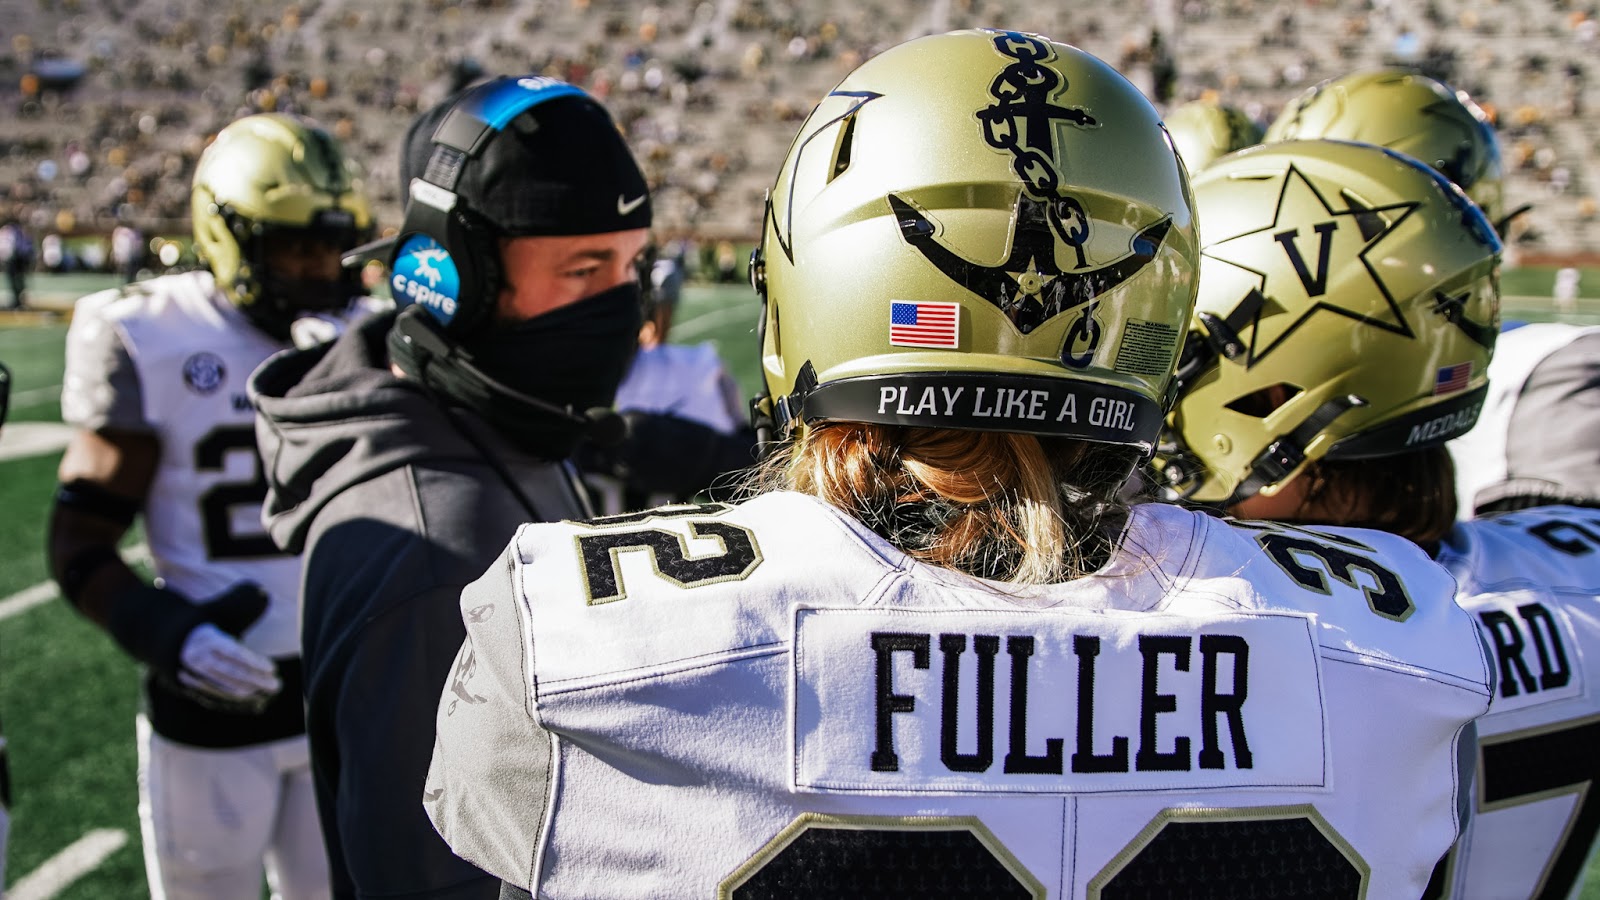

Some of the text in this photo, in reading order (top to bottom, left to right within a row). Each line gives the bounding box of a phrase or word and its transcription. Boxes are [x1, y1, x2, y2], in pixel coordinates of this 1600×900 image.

[406, 280, 458, 316] spire
[1273, 221, 1339, 298] V
[877, 386, 1136, 431] PLAY LIKE A GIRL
[1479, 602, 1571, 699] RD
[870, 631, 1254, 775] FULLER
